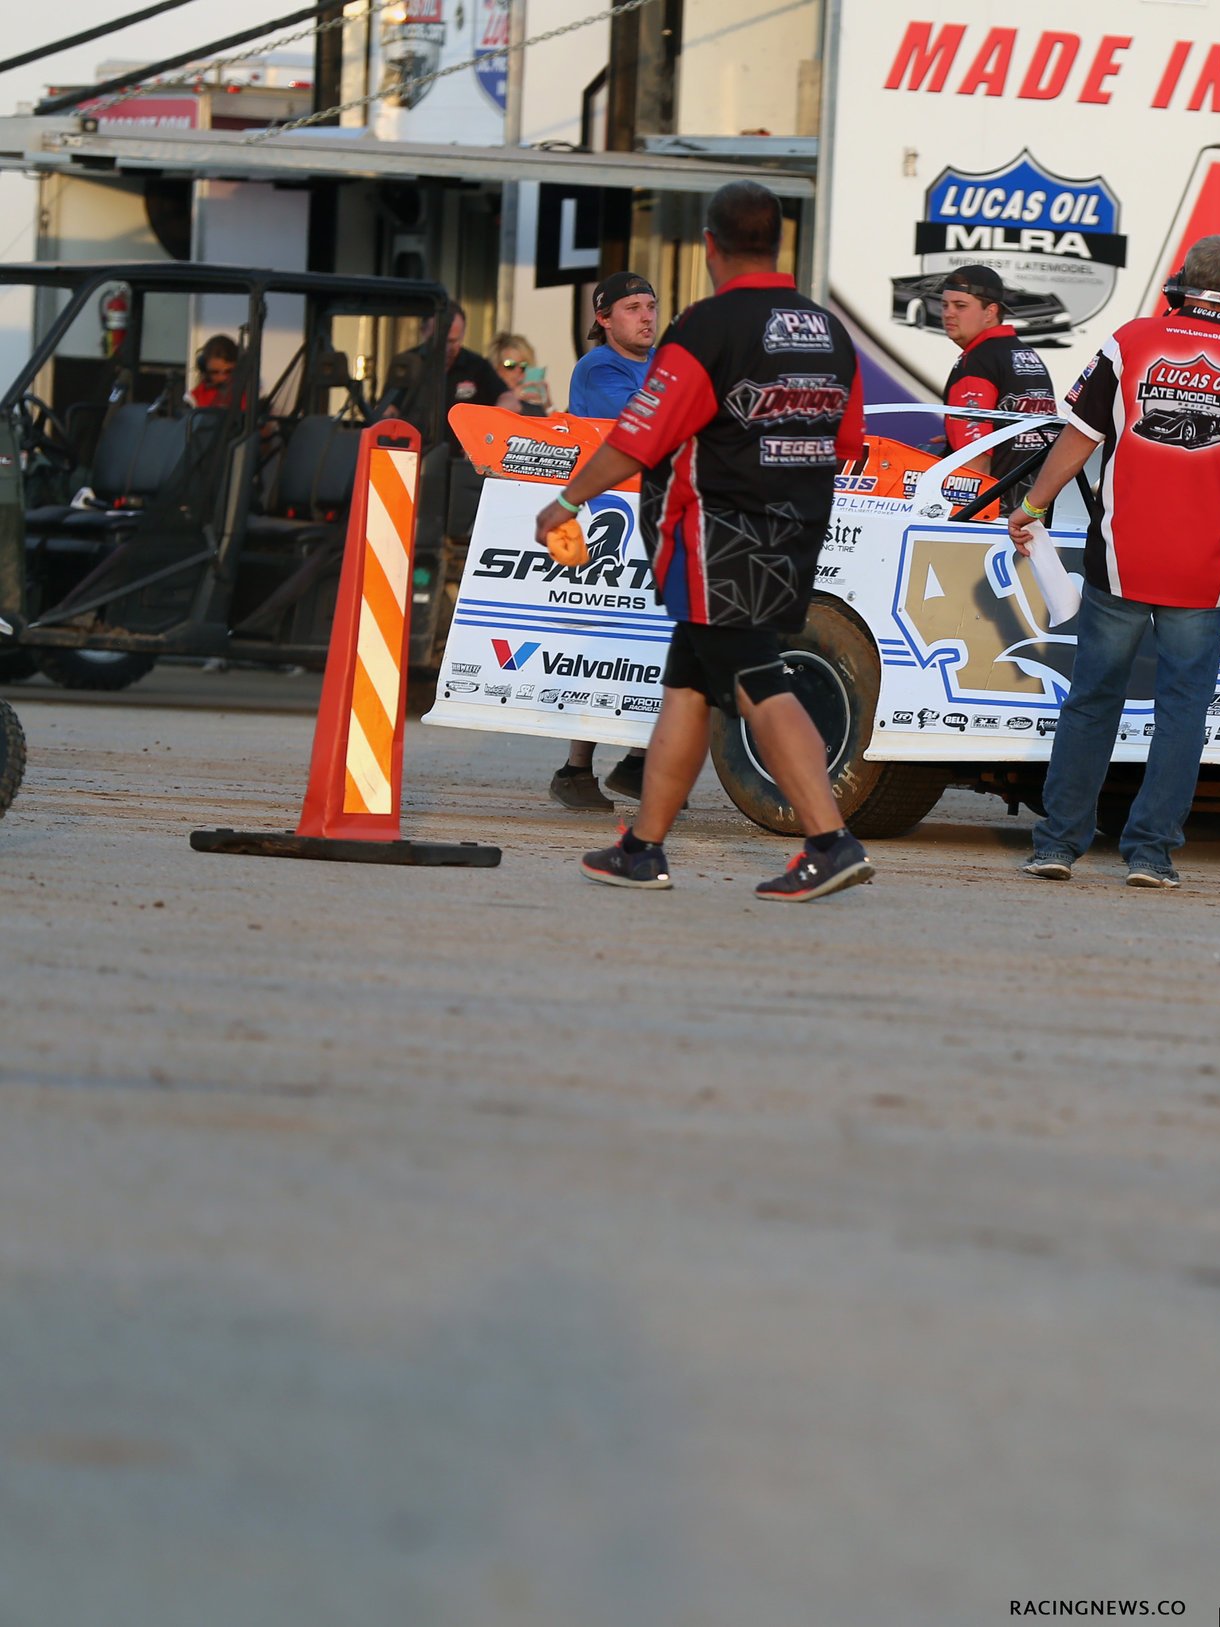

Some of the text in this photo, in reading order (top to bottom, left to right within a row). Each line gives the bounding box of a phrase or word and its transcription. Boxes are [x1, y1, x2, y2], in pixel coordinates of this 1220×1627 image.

[884, 21, 1133, 105] MADE
[939, 184, 1101, 226] LUCAS OIL
[944, 224, 1093, 260] MLRA
[1192, 306, 1216, 318] LUCAS
[791, 332, 830, 342] SALES
[1155, 367, 1210, 389] LUCAS
[1140, 385, 1175, 401] LATE
[506, 436, 581, 459] Midwest
[505, 453, 539, 463] SHEET
[540, 457, 572, 467] METAL
[947, 475, 981, 493] POINT
[850, 499, 914, 513] LITHIUM
[837, 545, 856, 553] TIRE
[548, 590, 646, 610] MOWERS
[542, 651, 662, 684] Valvoline
[561, 690, 591, 701] CNR
[945, 715, 966, 724] BELL
